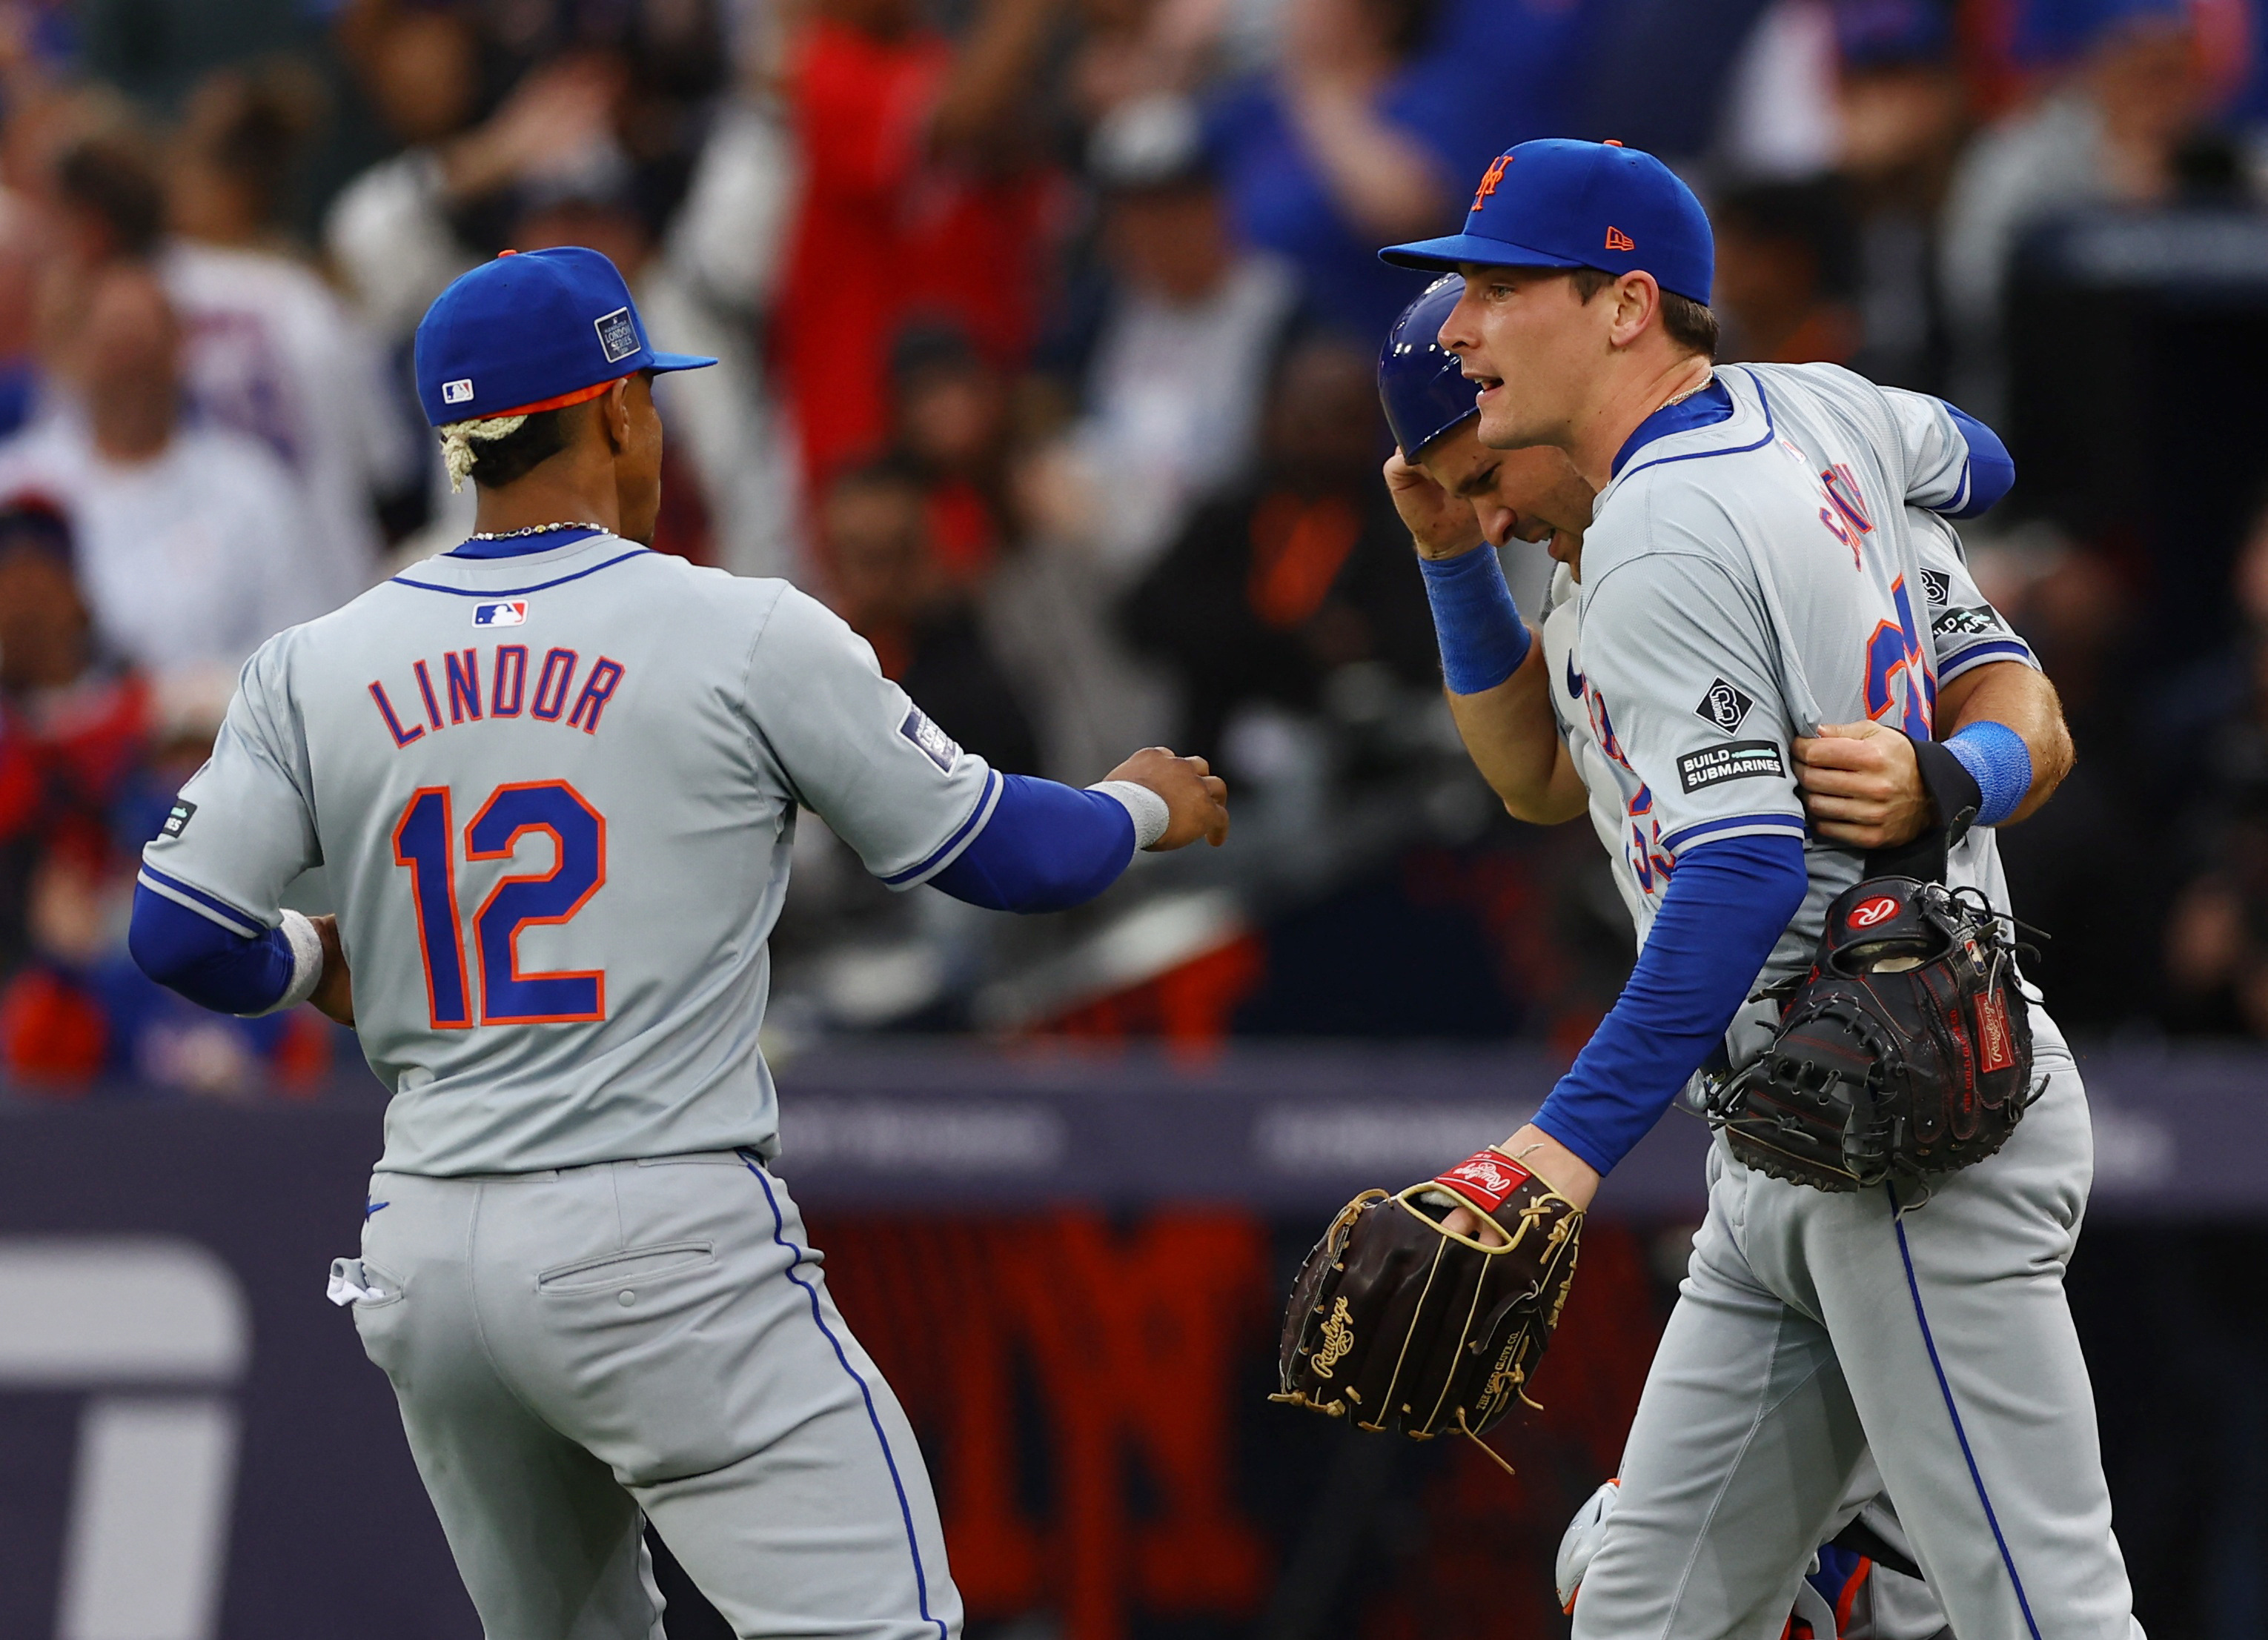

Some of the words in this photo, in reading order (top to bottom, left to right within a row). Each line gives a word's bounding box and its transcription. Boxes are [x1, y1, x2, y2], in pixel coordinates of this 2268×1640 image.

[605, 326, 631, 344] LONDON
[611, 335, 632, 348] SERIES
[368, 645, 625, 749] LINDOR
[1709, 684, 1742, 727] 3
[1683, 749, 1730, 773] BUILD
[1687, 759, 1781, 786] SUBMARINES
[391, 778, 606, 1029] 12
[1311, 1295, 1354, 1378] Rawlings
[1476, 1388, 1491, 1410] THE
[1495, 1343, 1511, 1371] GLOVE
